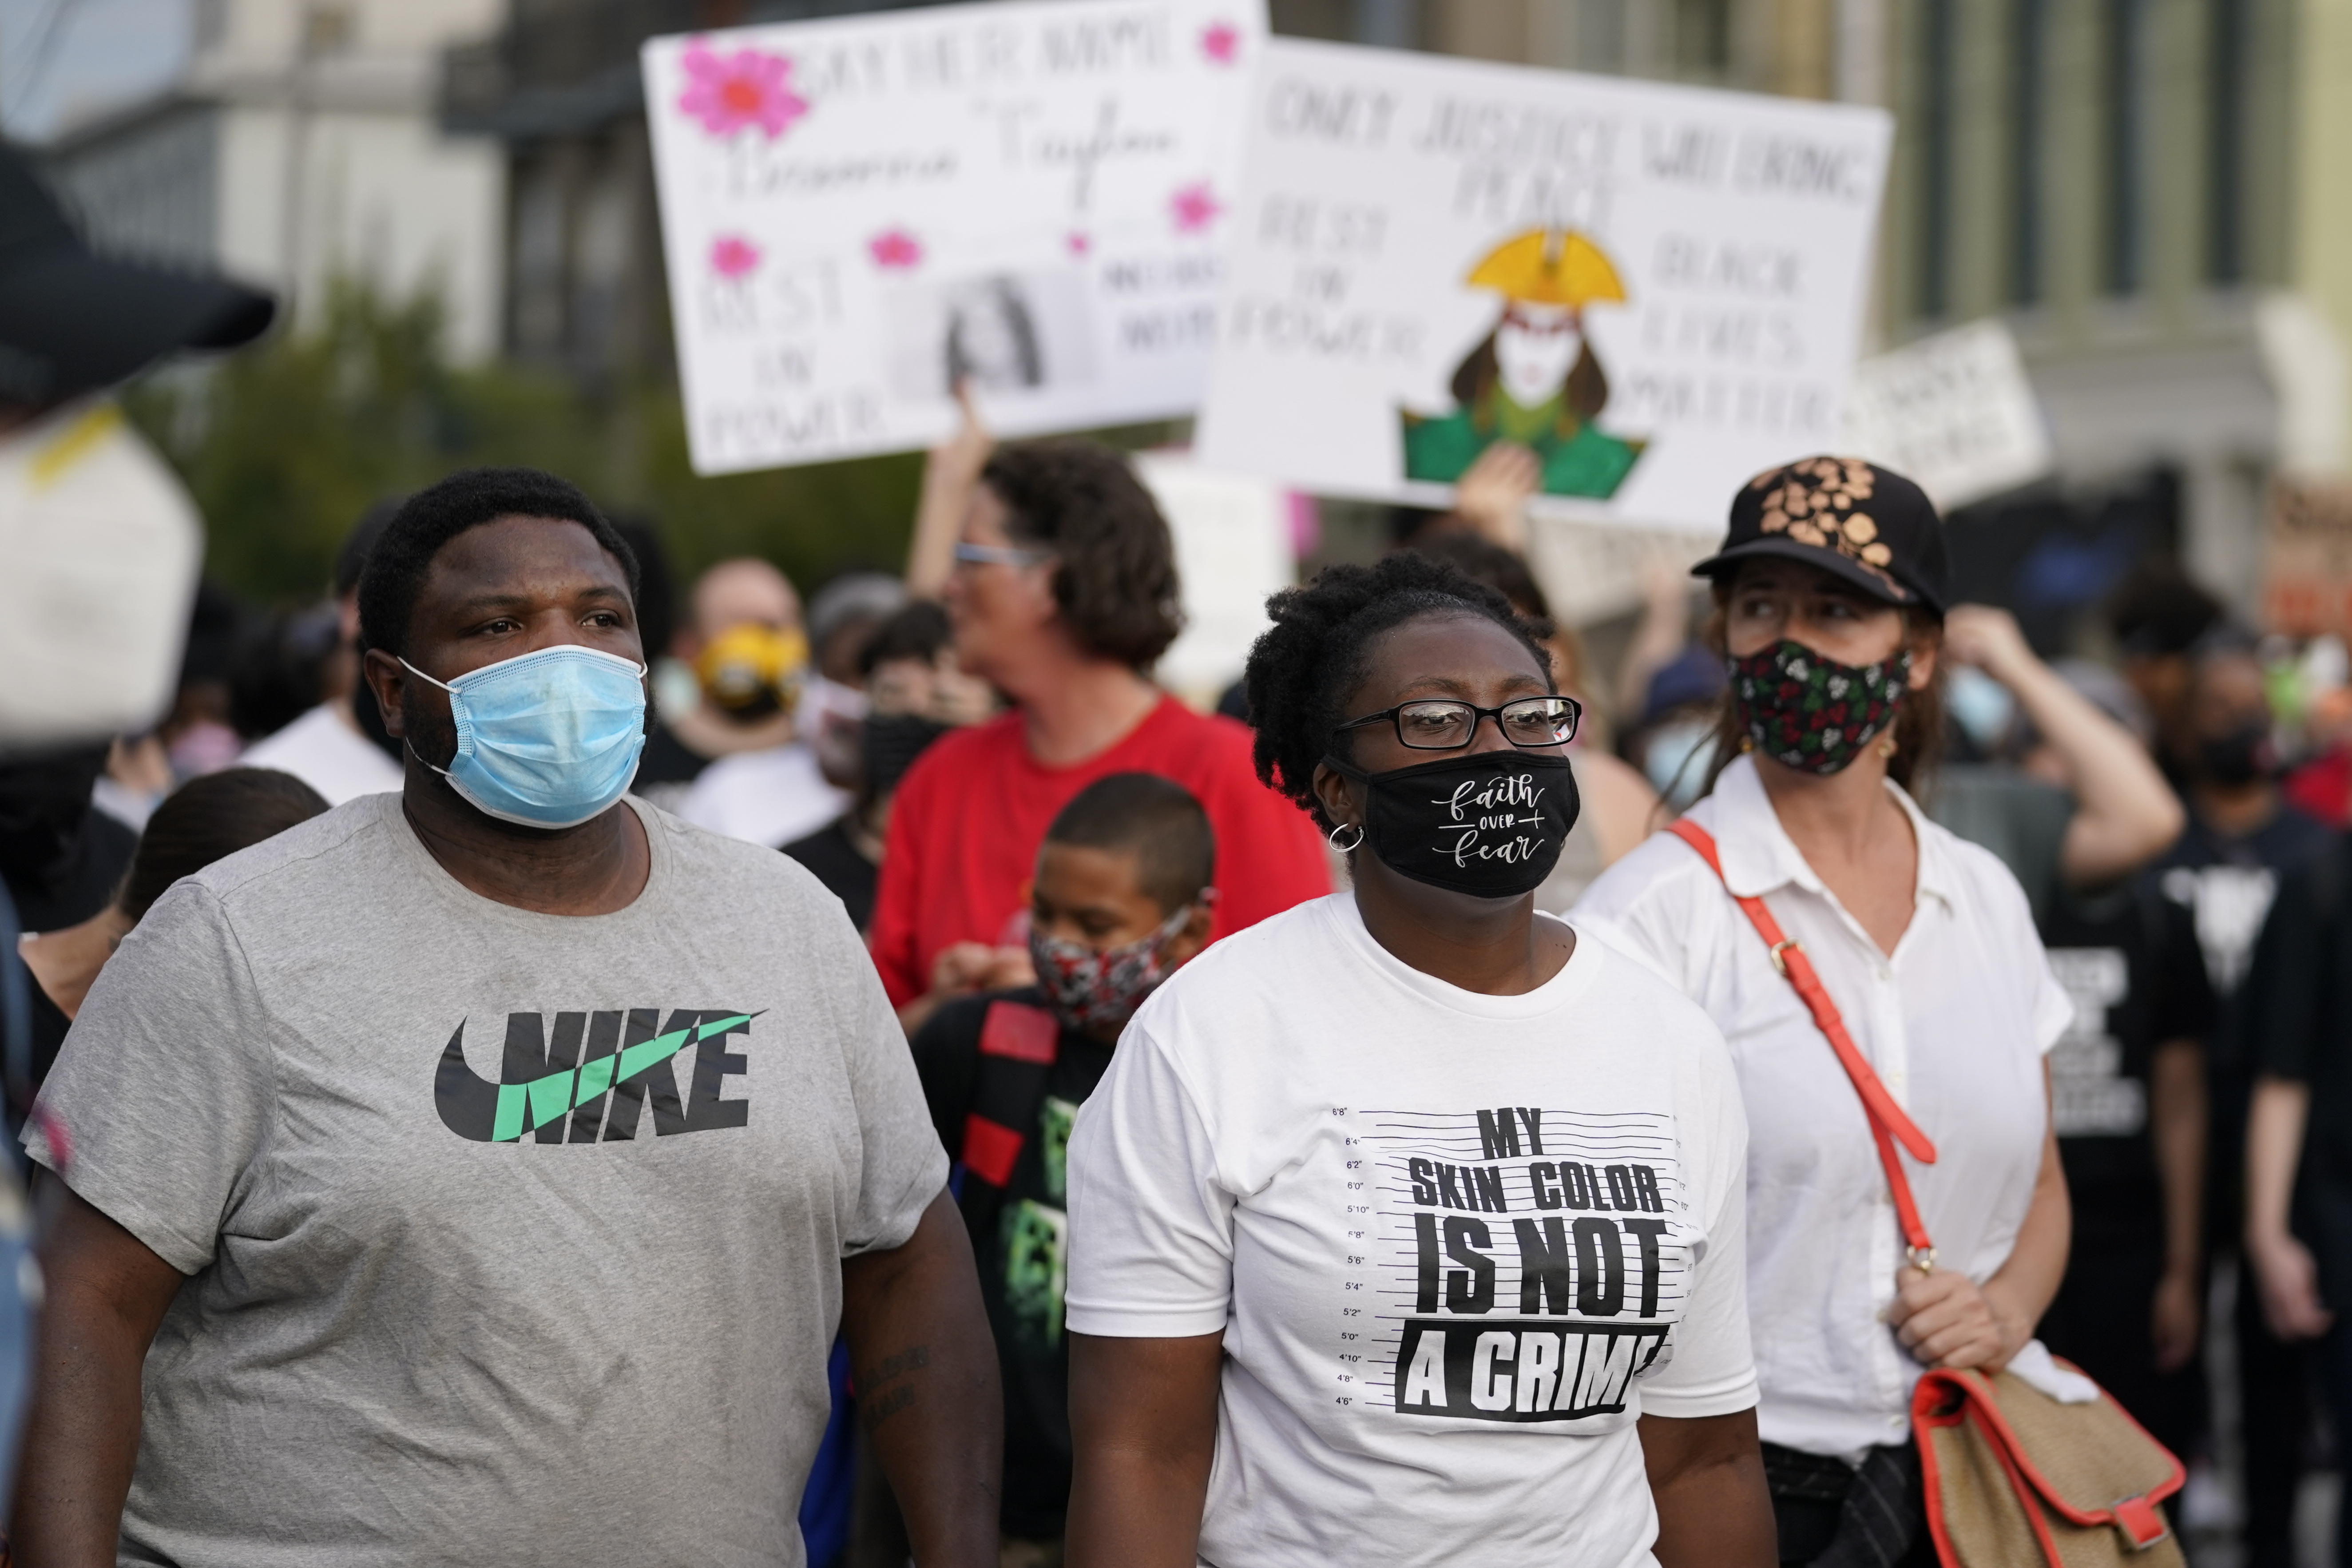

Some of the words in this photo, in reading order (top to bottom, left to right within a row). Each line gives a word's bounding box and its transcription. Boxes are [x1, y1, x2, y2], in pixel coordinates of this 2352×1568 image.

[1431, 774, 1545, 821] faith
[1479, 814, 1515, 830] OVER
[1432, 830, 1545, 868] fear
[491, 1008, 751, 1144] NIKE
[1476, 1108, 1543, 1160] MY
[1409, 1157, 1507, 1213] SKIN
[1529, 1161, 1664, 1213] COLOR
[1415, 1213, 1495, 1314] IS
[1512, 1217, 1668, 1318] NOT
[1404, 1330, 1448, 1407] A
